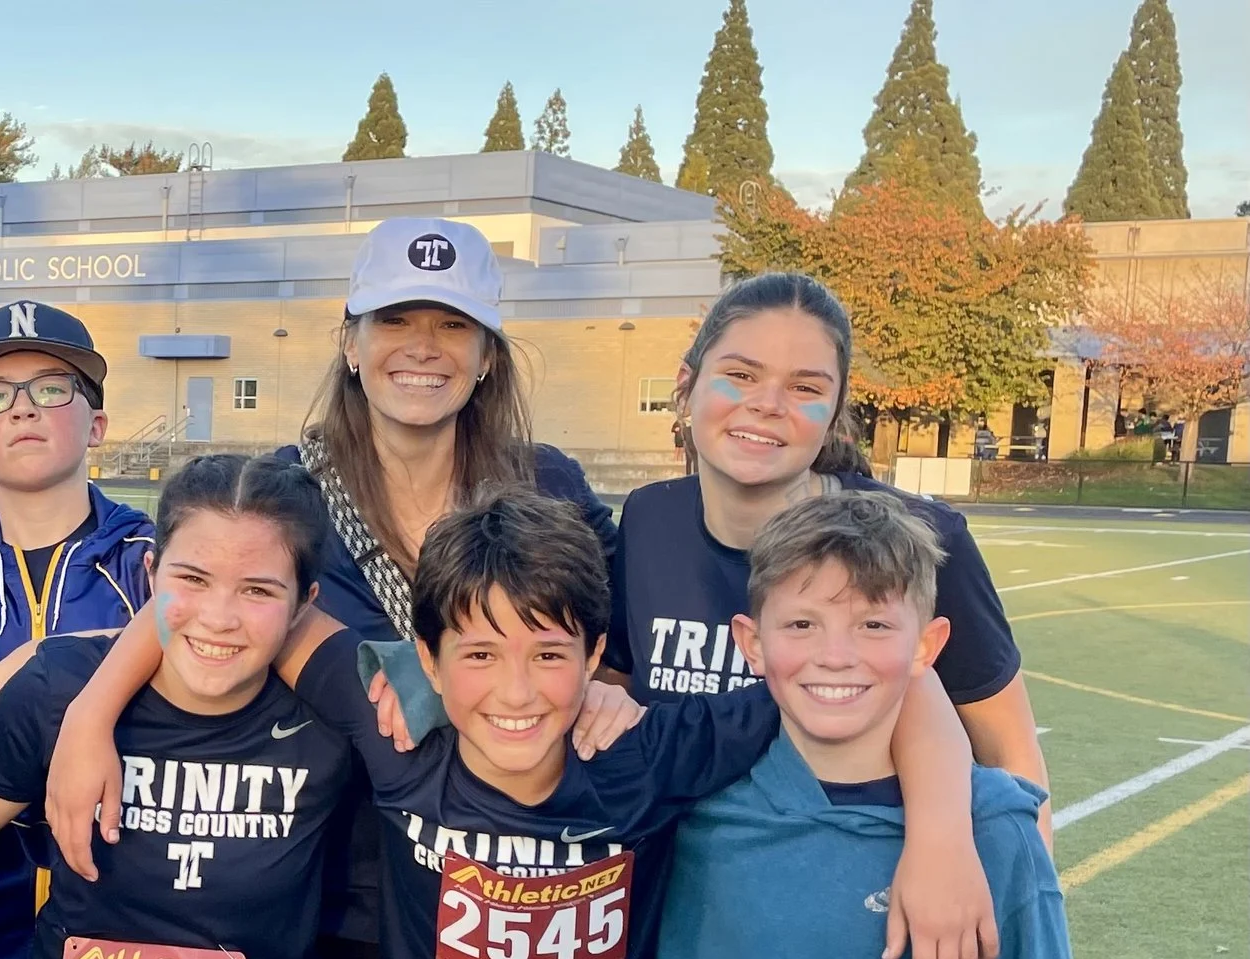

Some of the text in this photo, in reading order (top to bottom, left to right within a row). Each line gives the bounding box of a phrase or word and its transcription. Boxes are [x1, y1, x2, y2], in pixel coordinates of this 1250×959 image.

[47, 254, 146, 281] SCHOOL
[9, 302, 39, 338] N
[649, 666, 721, 694] CROSS
[121, 755, 310, 813] RINITY
[95, 803, 295, 838] OSS COUNTRY
